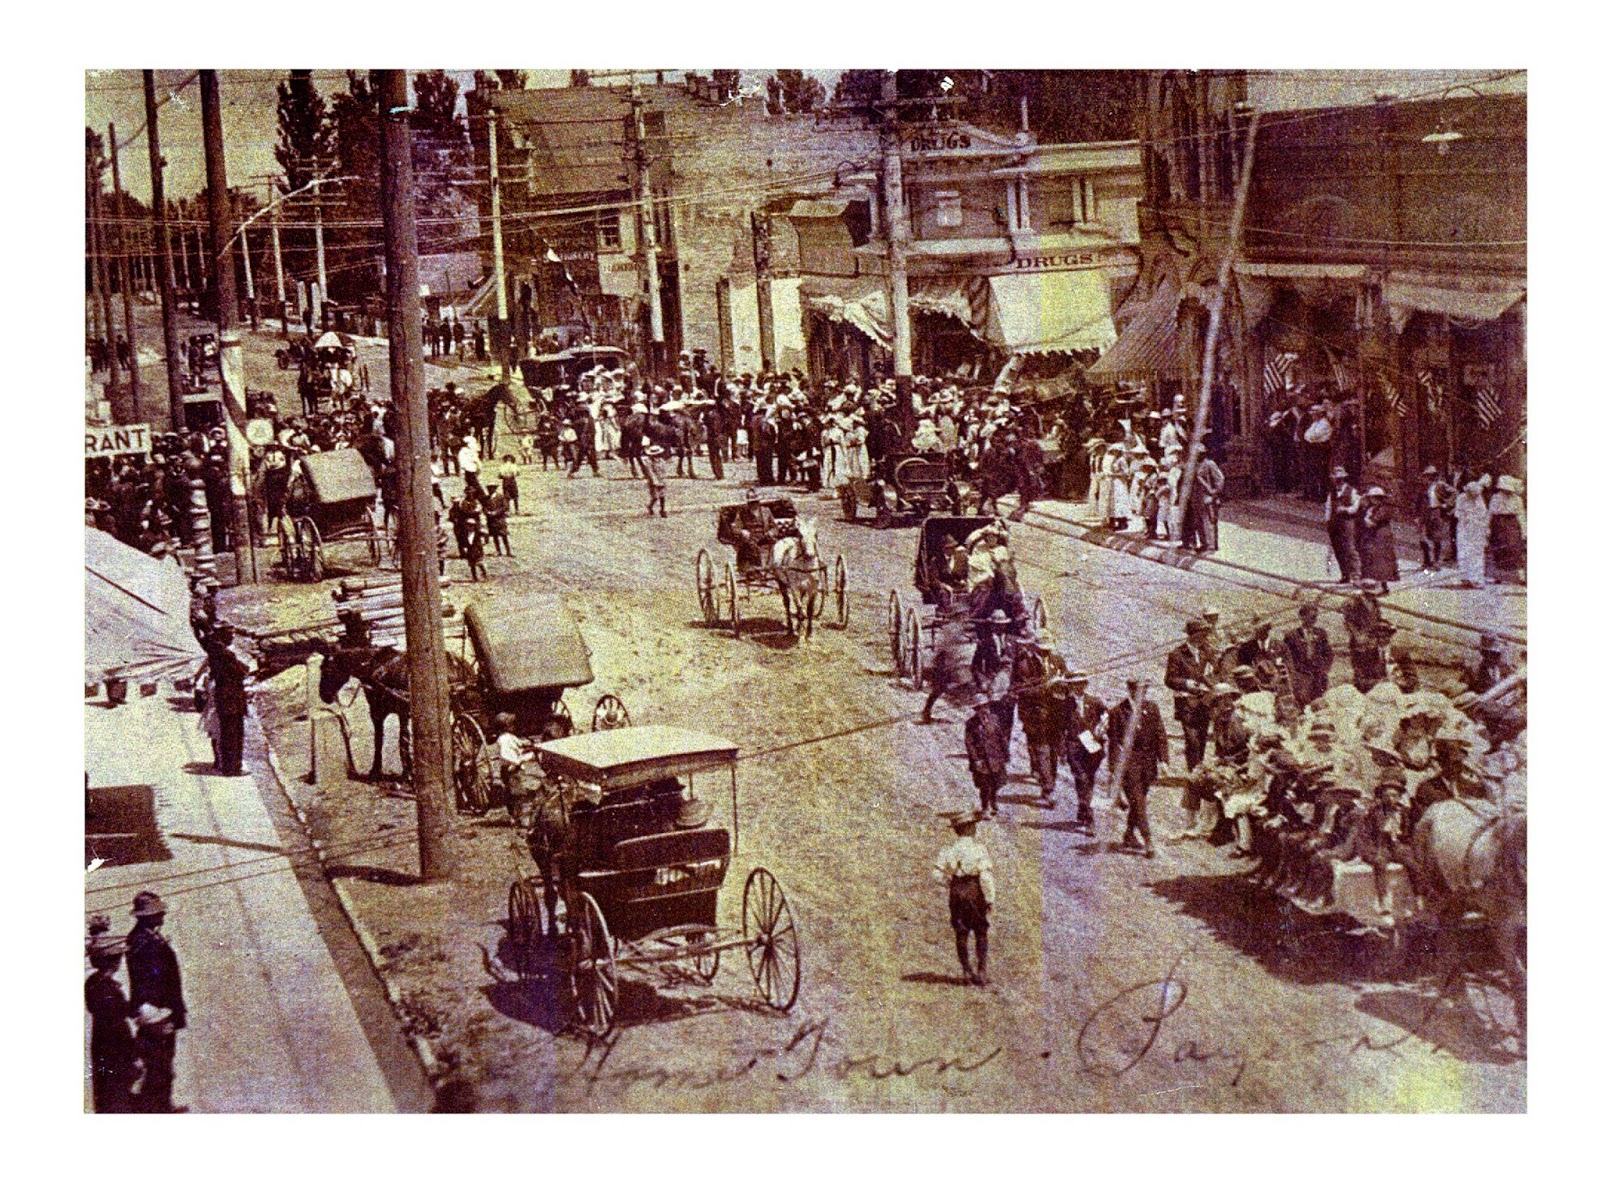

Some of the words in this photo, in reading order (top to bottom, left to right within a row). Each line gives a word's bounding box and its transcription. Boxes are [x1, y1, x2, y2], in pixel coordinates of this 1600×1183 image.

[911, 132, 971, 151] DRUGS
[1016, 253, 1094, 269] DRUGS
[85, 428, 145, 451] RANT
